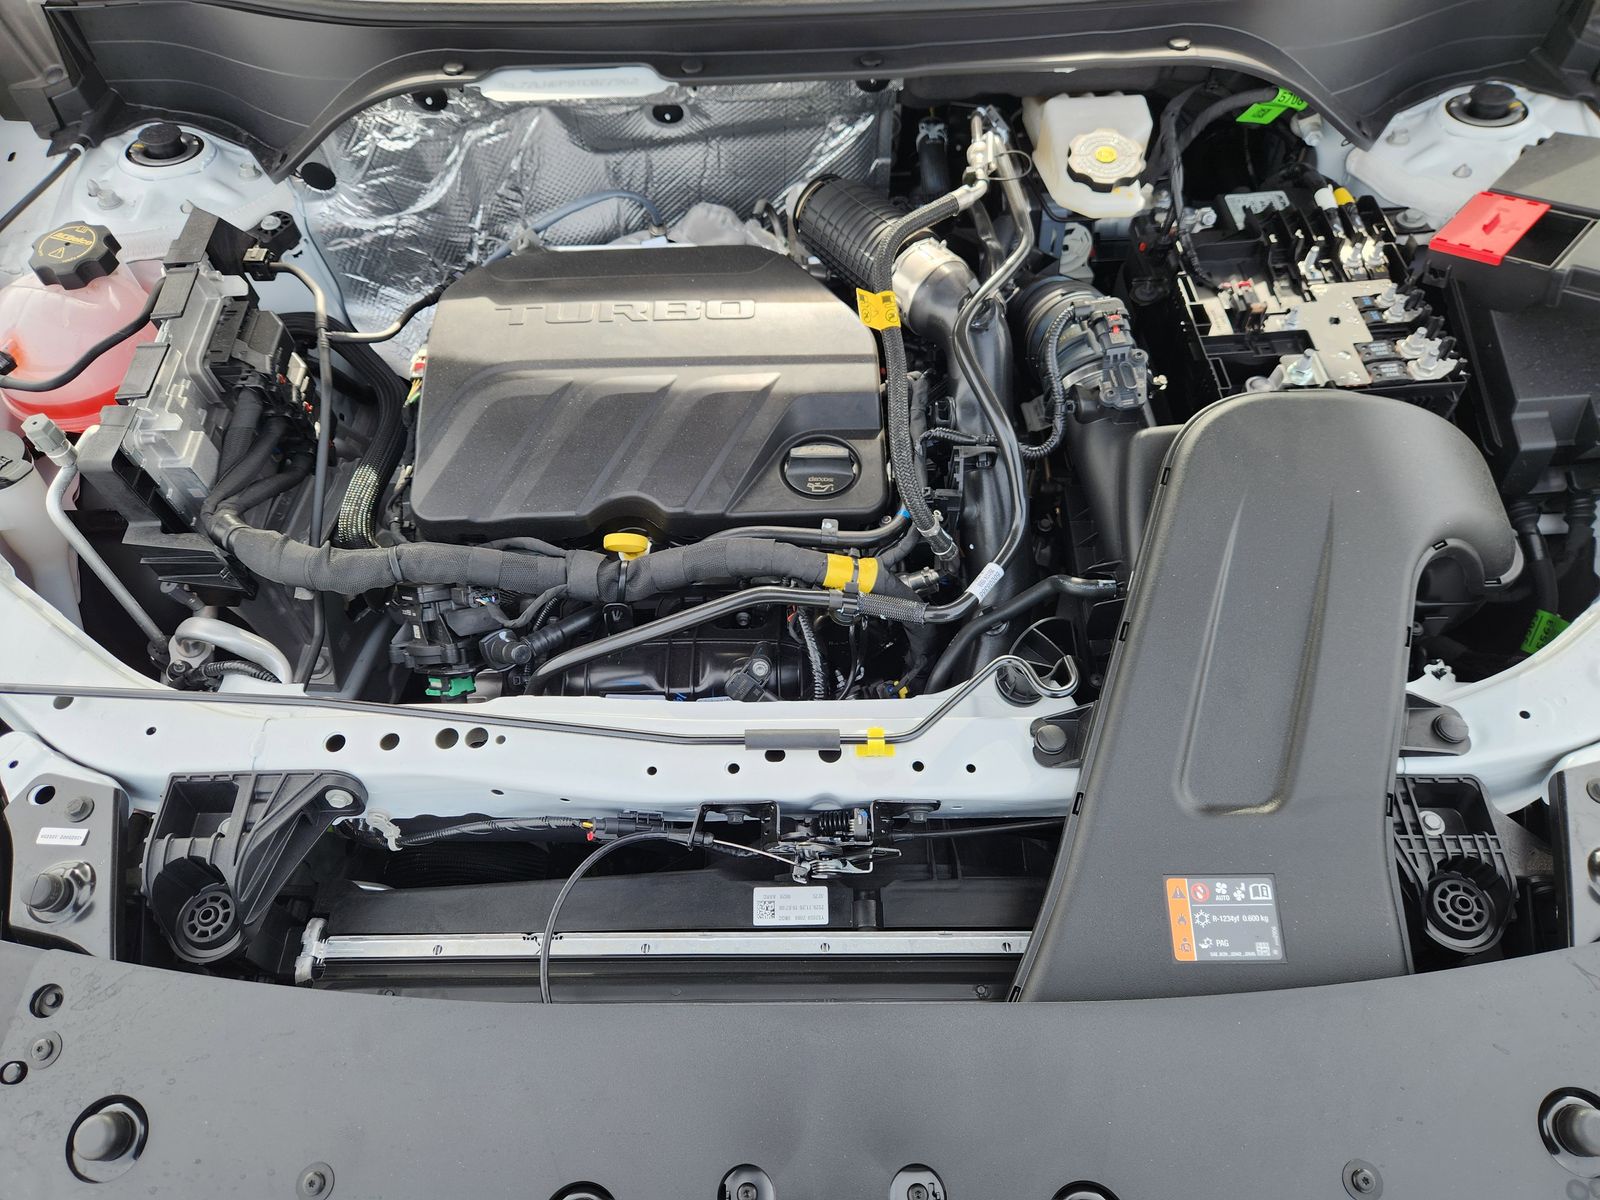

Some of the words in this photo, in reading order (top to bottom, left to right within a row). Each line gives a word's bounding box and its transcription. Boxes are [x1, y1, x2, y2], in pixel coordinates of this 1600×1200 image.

[494, 300, 756, 326] TURBO
[1212, 915, 1240, 923] R-1234yf
[1260, 914, 1269, 923] kg
[1216, 939, 1229, 947] PAG
